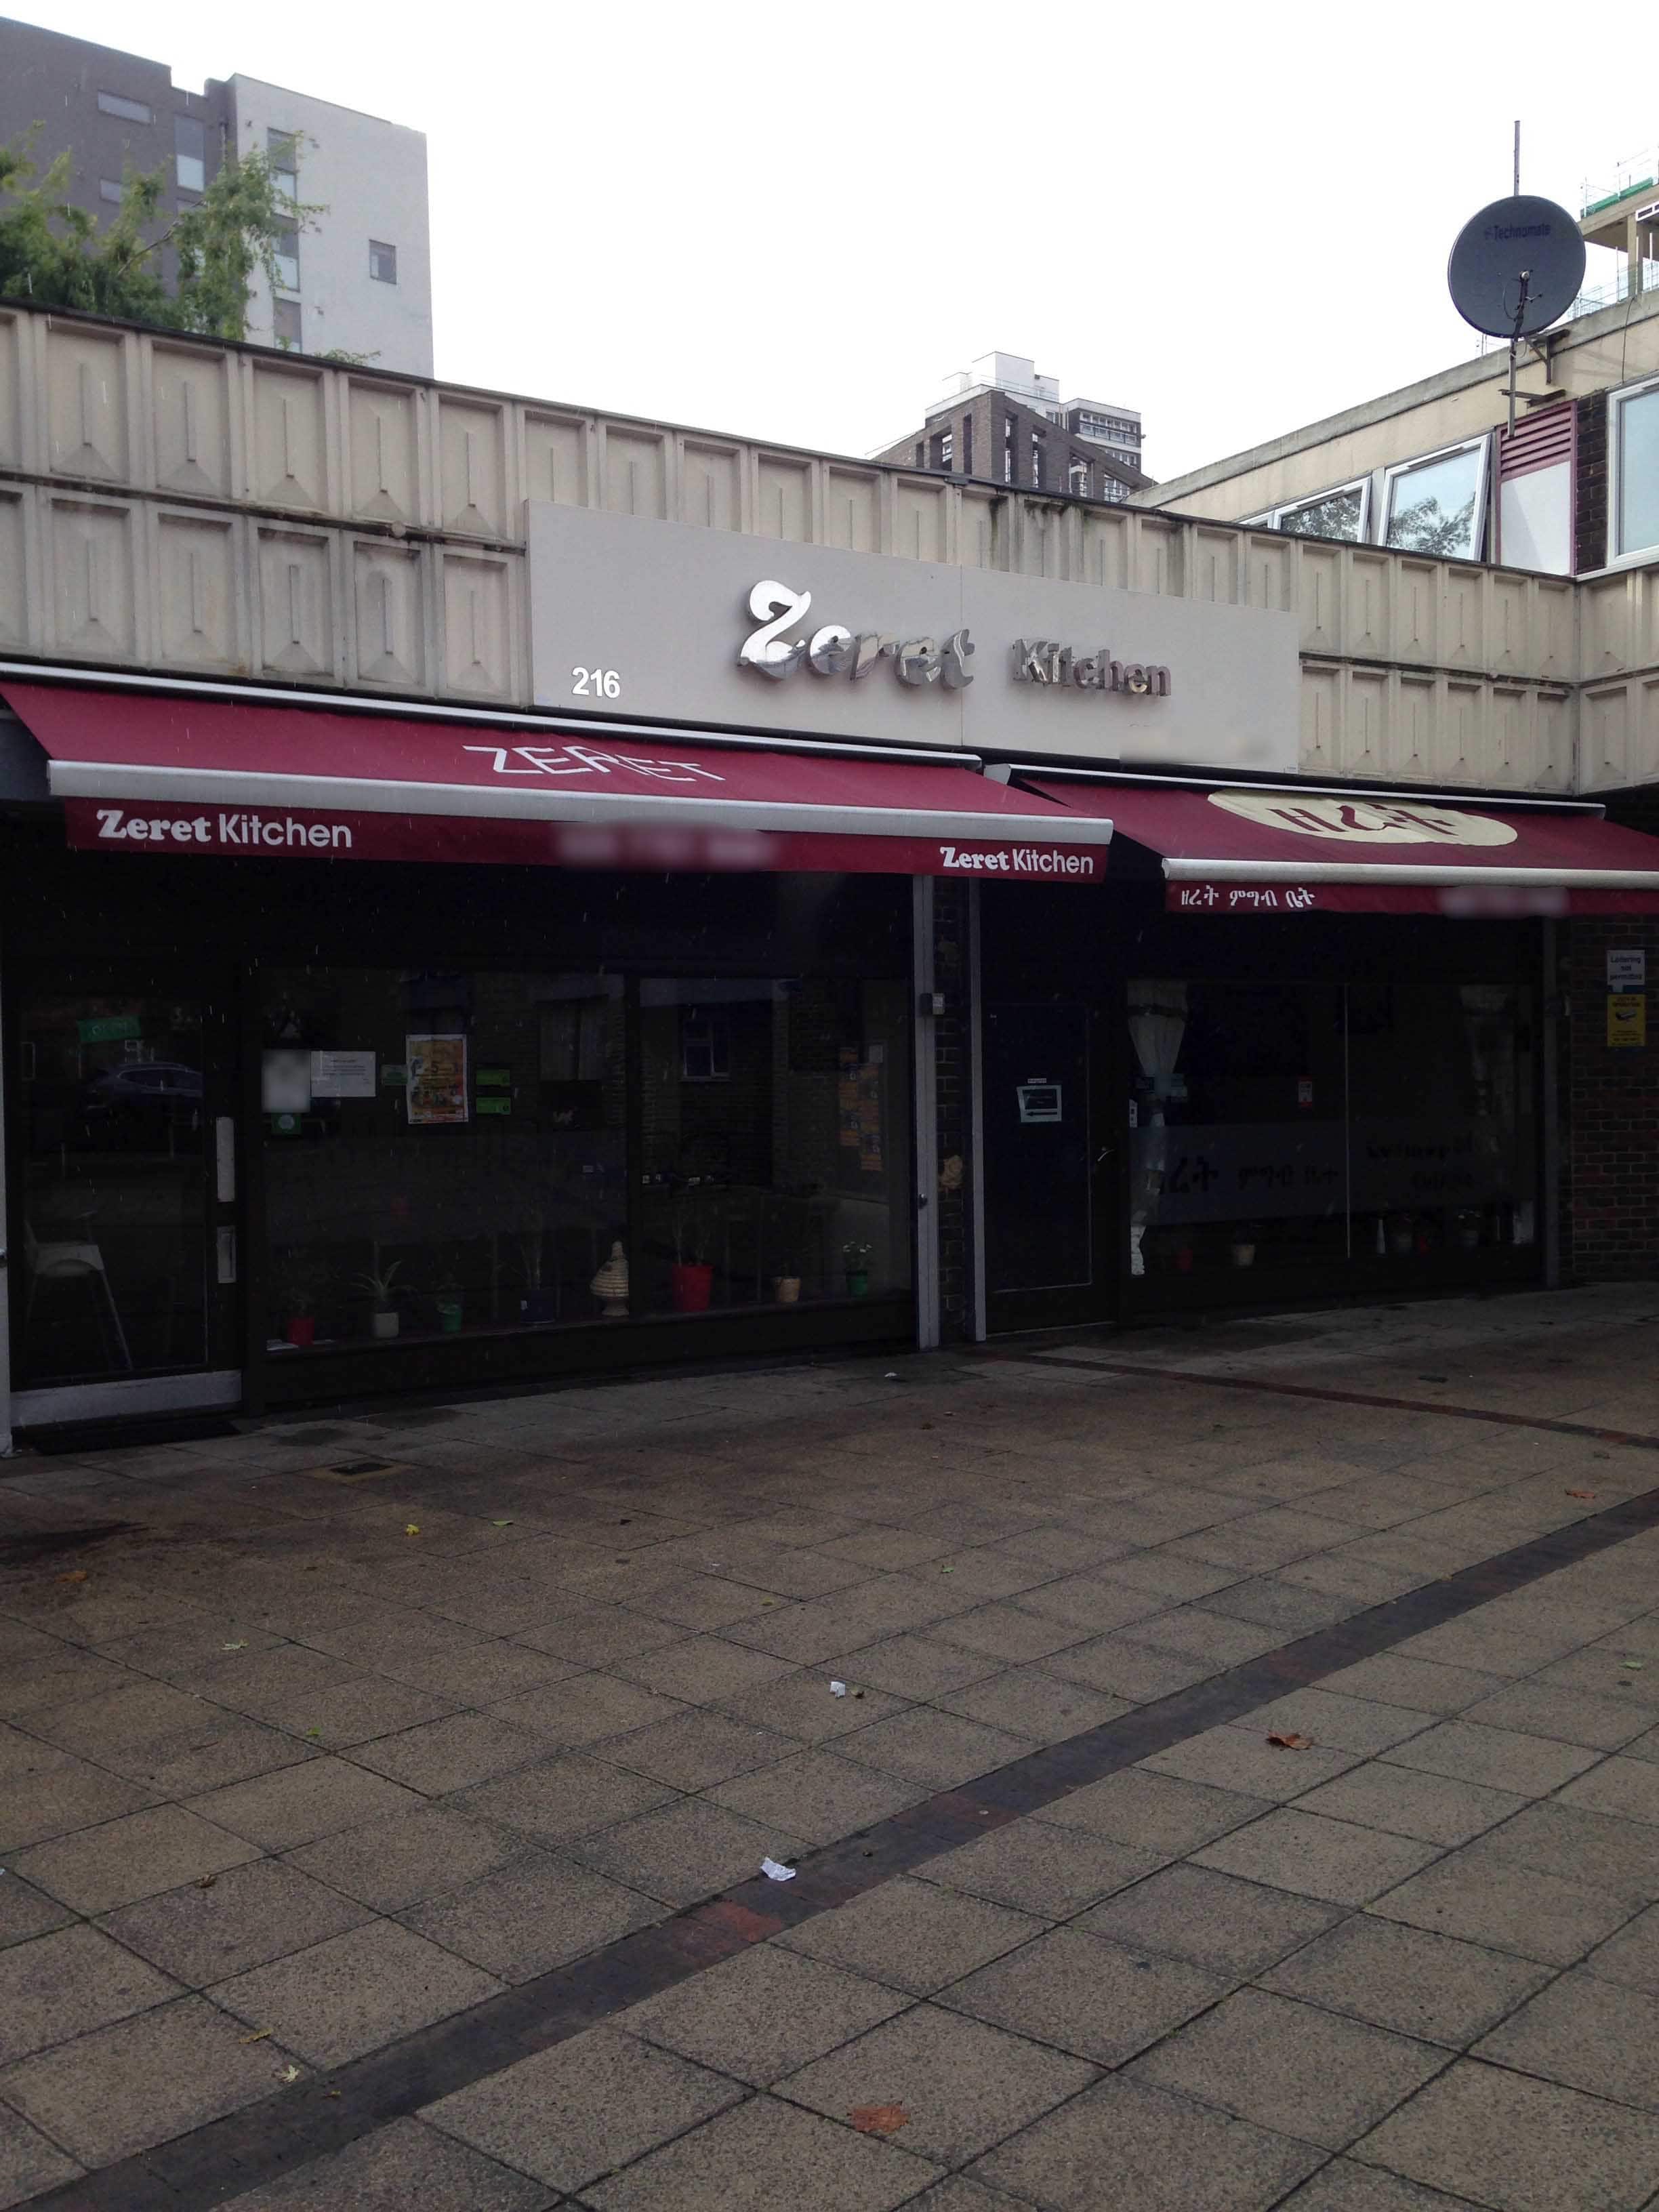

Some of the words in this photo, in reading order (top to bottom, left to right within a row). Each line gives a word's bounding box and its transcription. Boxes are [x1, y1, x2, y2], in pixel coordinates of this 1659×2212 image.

[735, 579, 976, 690] Zeret
[1012, 637, 1172, 698] Kitchen
[571, 667, 621, 699] 216
[462, 745, 726, 781] ZERET
[96, 809, 212, 843] Zeret
[218, 813, 352, 848] Kitchen
[939, 846, 1010, 871] Zeret
[1012, 848, 1094, 874] Kitchen
[1181, 884, 1219, 906] ዘረት
[1285, 886, 1315, 908] ቤት
